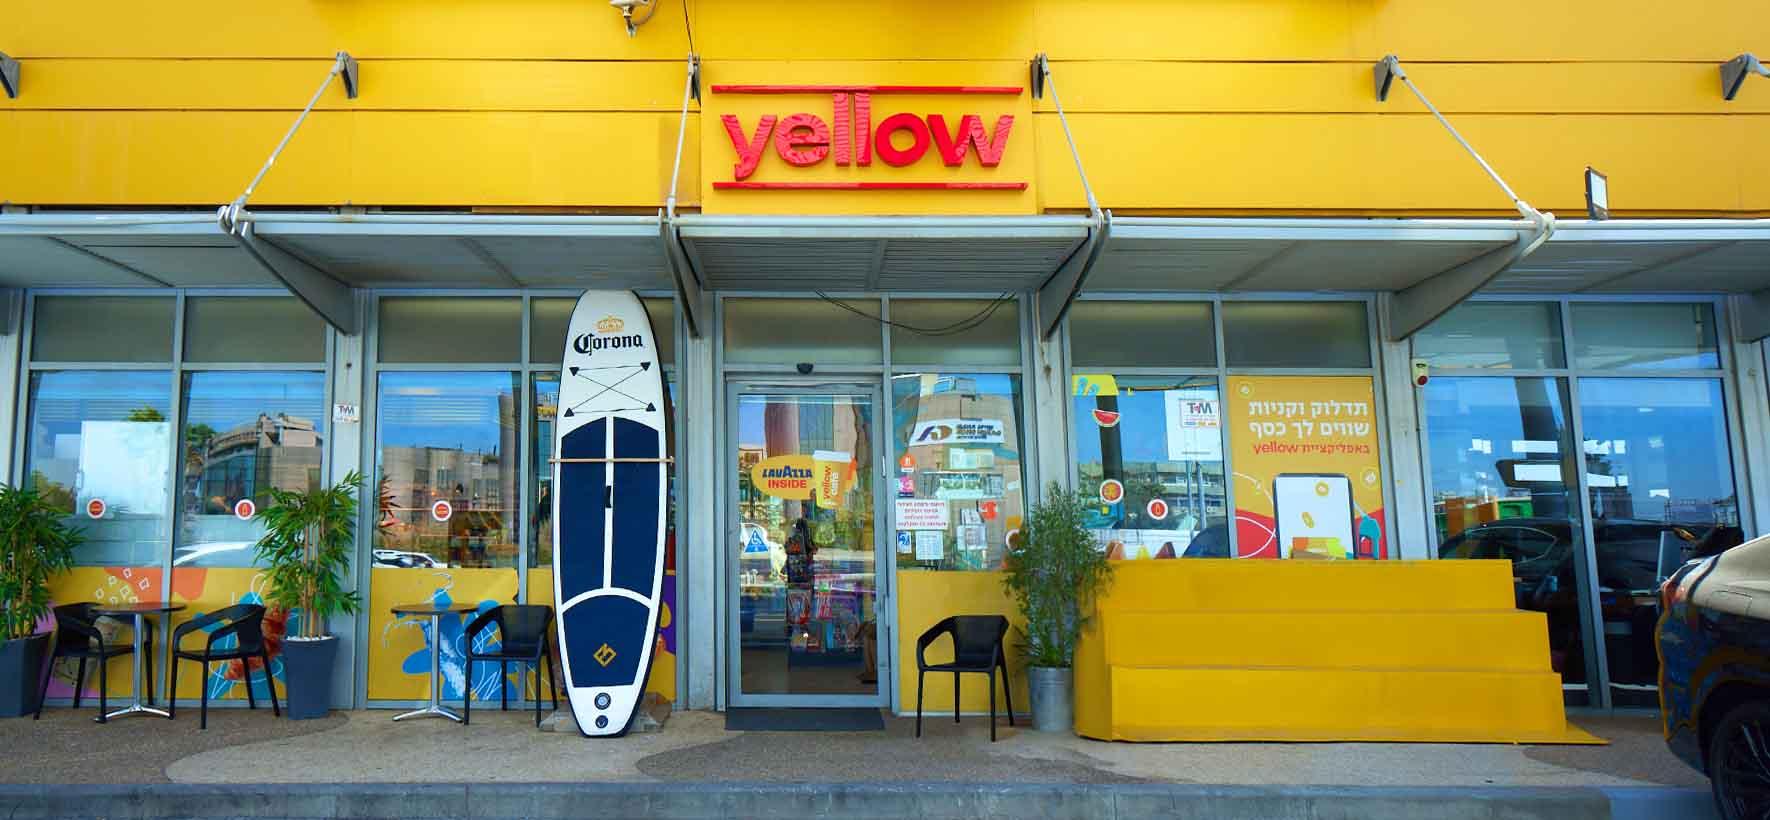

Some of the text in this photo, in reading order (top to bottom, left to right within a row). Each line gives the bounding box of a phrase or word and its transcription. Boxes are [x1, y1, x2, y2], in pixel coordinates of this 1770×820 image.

[720, 91, 1015, 181] yellow
[573, 333, 643, 356] Corona
[1248, 400, 1368, 418] תדלוק וקניות
[1248, 419, 1370, 439] שווים לך כסף
[1253, 441, 1299, 455] yellow
[767, 479, 807, 489] INSIDE
